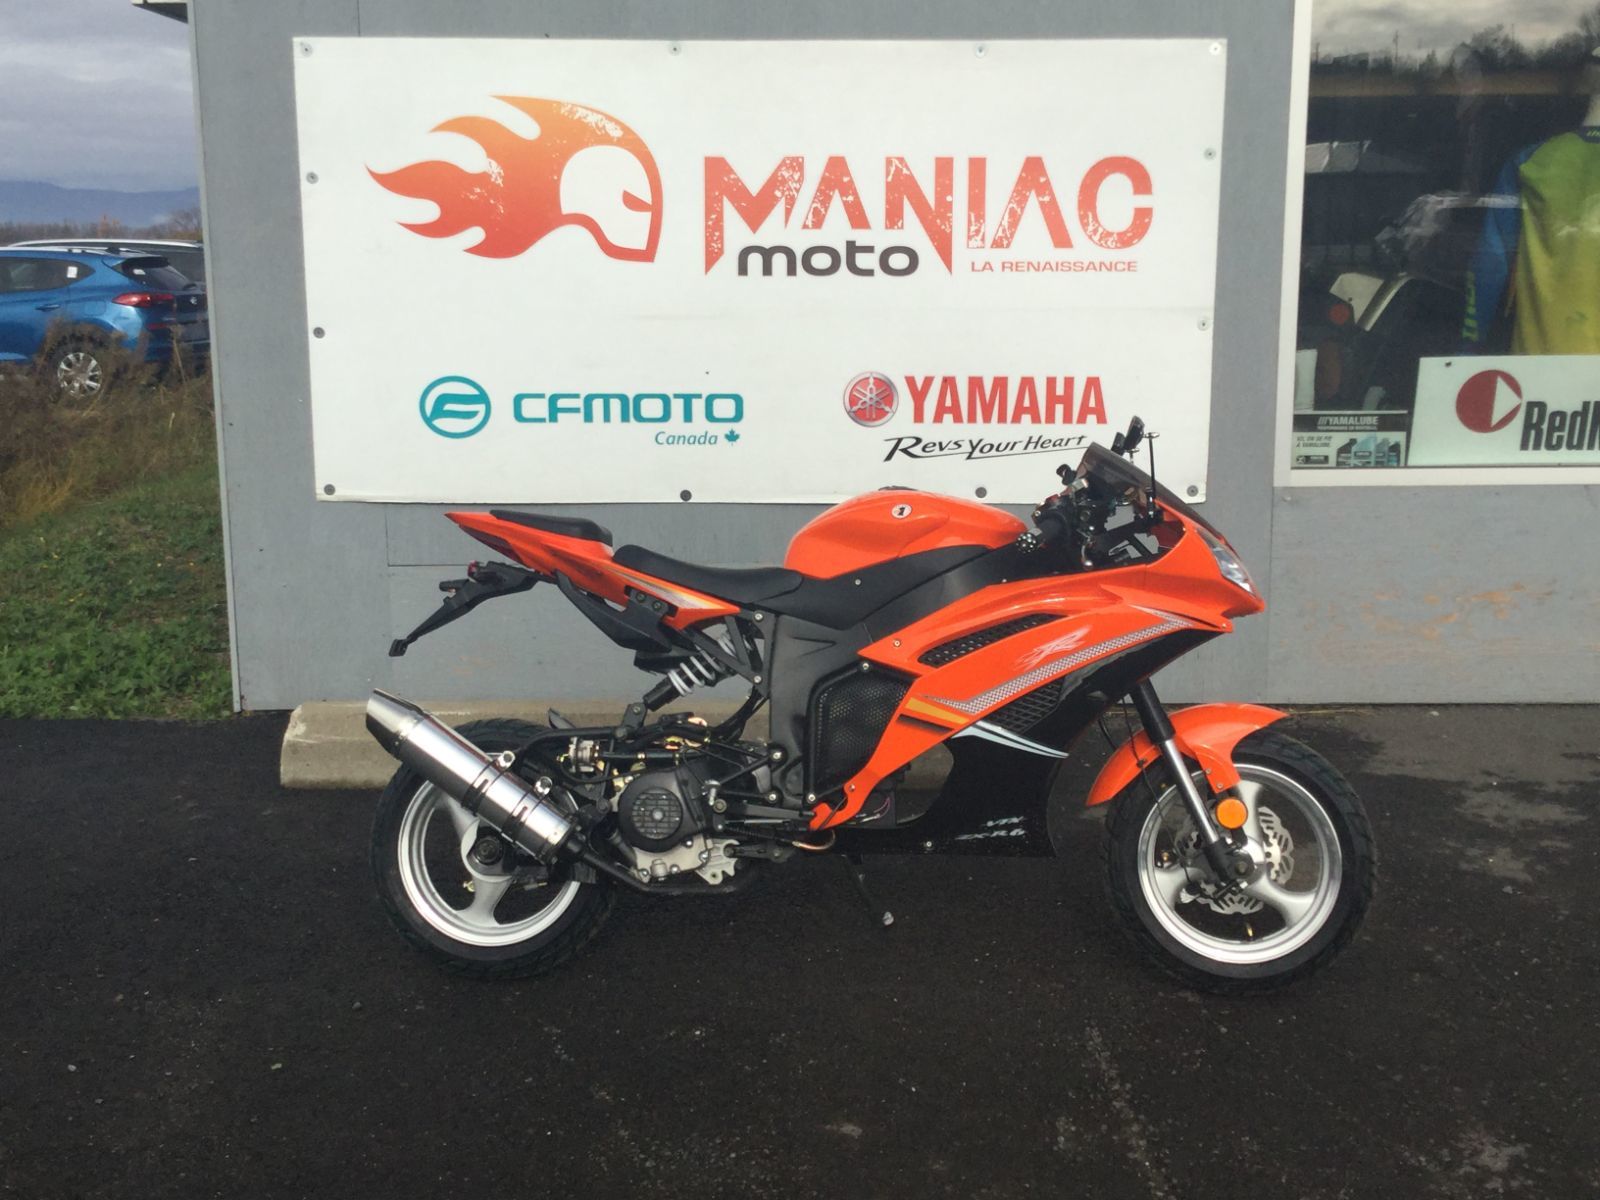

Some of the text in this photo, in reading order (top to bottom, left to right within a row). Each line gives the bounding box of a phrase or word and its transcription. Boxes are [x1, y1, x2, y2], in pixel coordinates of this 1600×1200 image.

[704, 156, 1153, 275] MANIAC
[738, 240, 919, 277] moto
[971, 261, 1138, 272] LA RENAISSANCE
[513, 393, 744, 423] CFMOTO
[905, 376, 1107, 425] YAMAHA
[1327, 416, 1379, 425] YAMALUBE
[655, 430, 718, 446] Canada
[884, 434, 1088, 462] Revs Your Heart
